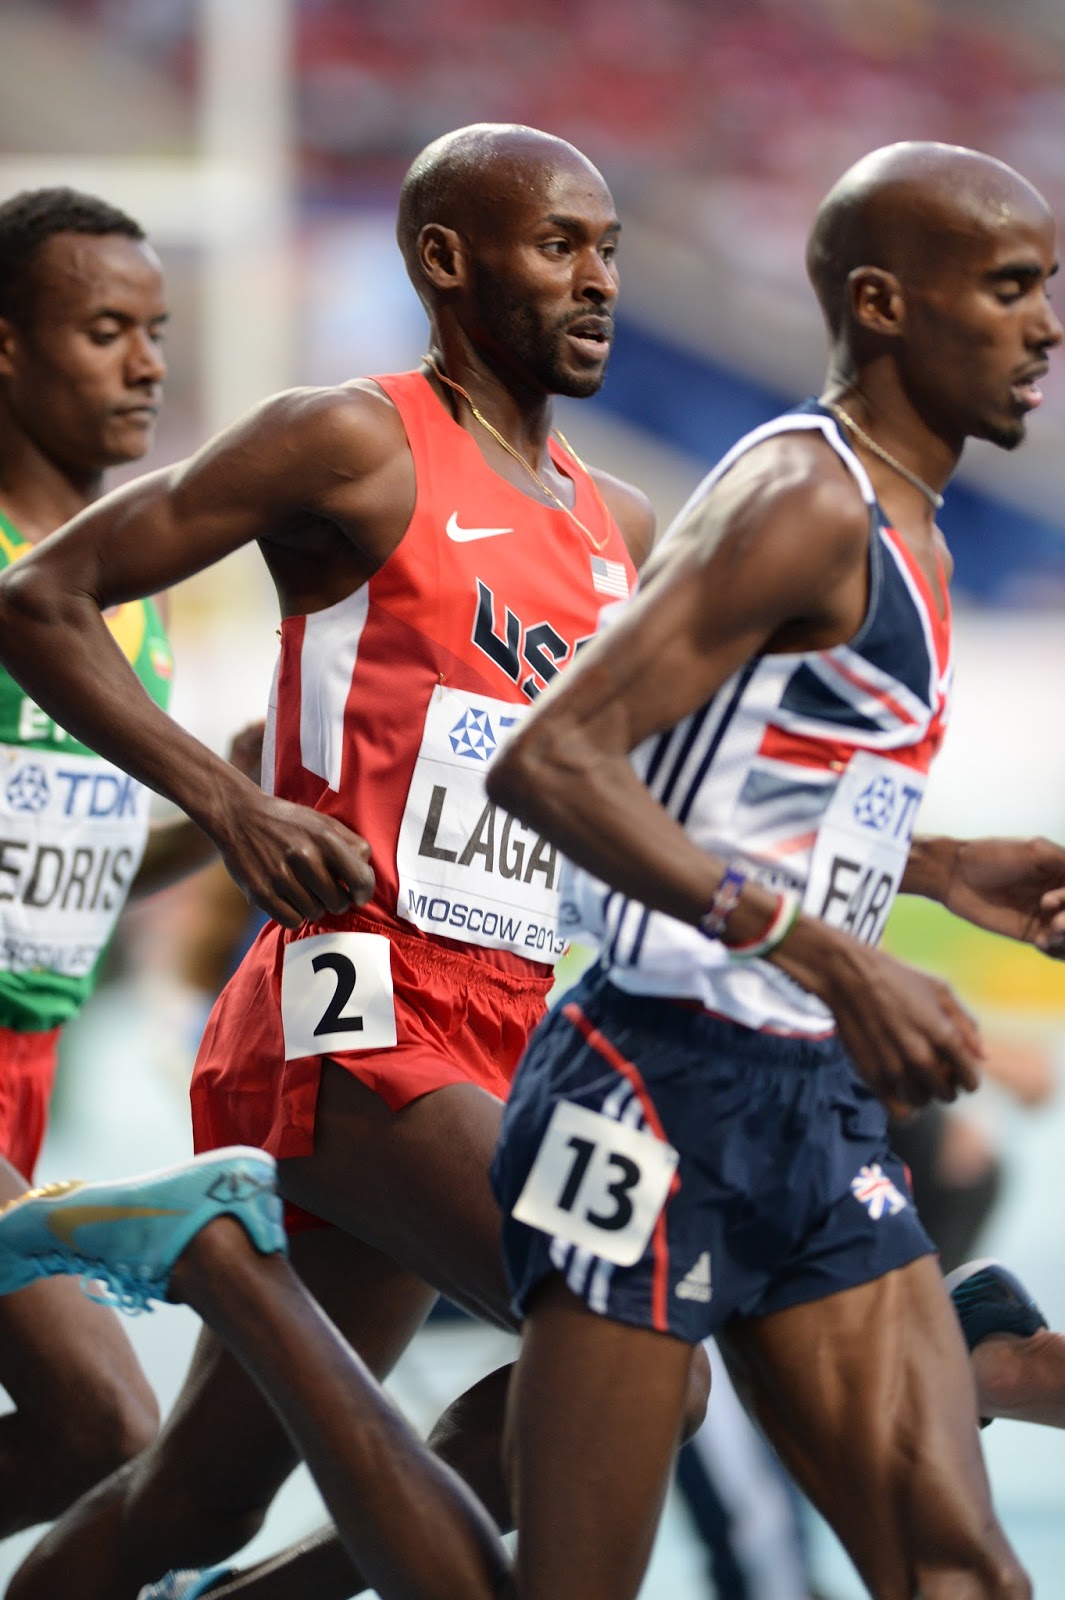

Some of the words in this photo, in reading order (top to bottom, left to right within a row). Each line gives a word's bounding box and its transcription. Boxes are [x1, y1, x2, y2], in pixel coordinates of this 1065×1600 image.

[471, 577, 596, 702] US
[56, 771, 139, 818] TDK
[418, 785, 560, 892] LAGA
[0, 839, 132, 911] EDRIS
[820, 856, 894, 947] FAR
[408, 889, 521, 942] MOSCOW
[525, 924, 565, 954] 2013
[311, 952, 364, 1037] 2
[557, 1136, 640, 1231] 13
